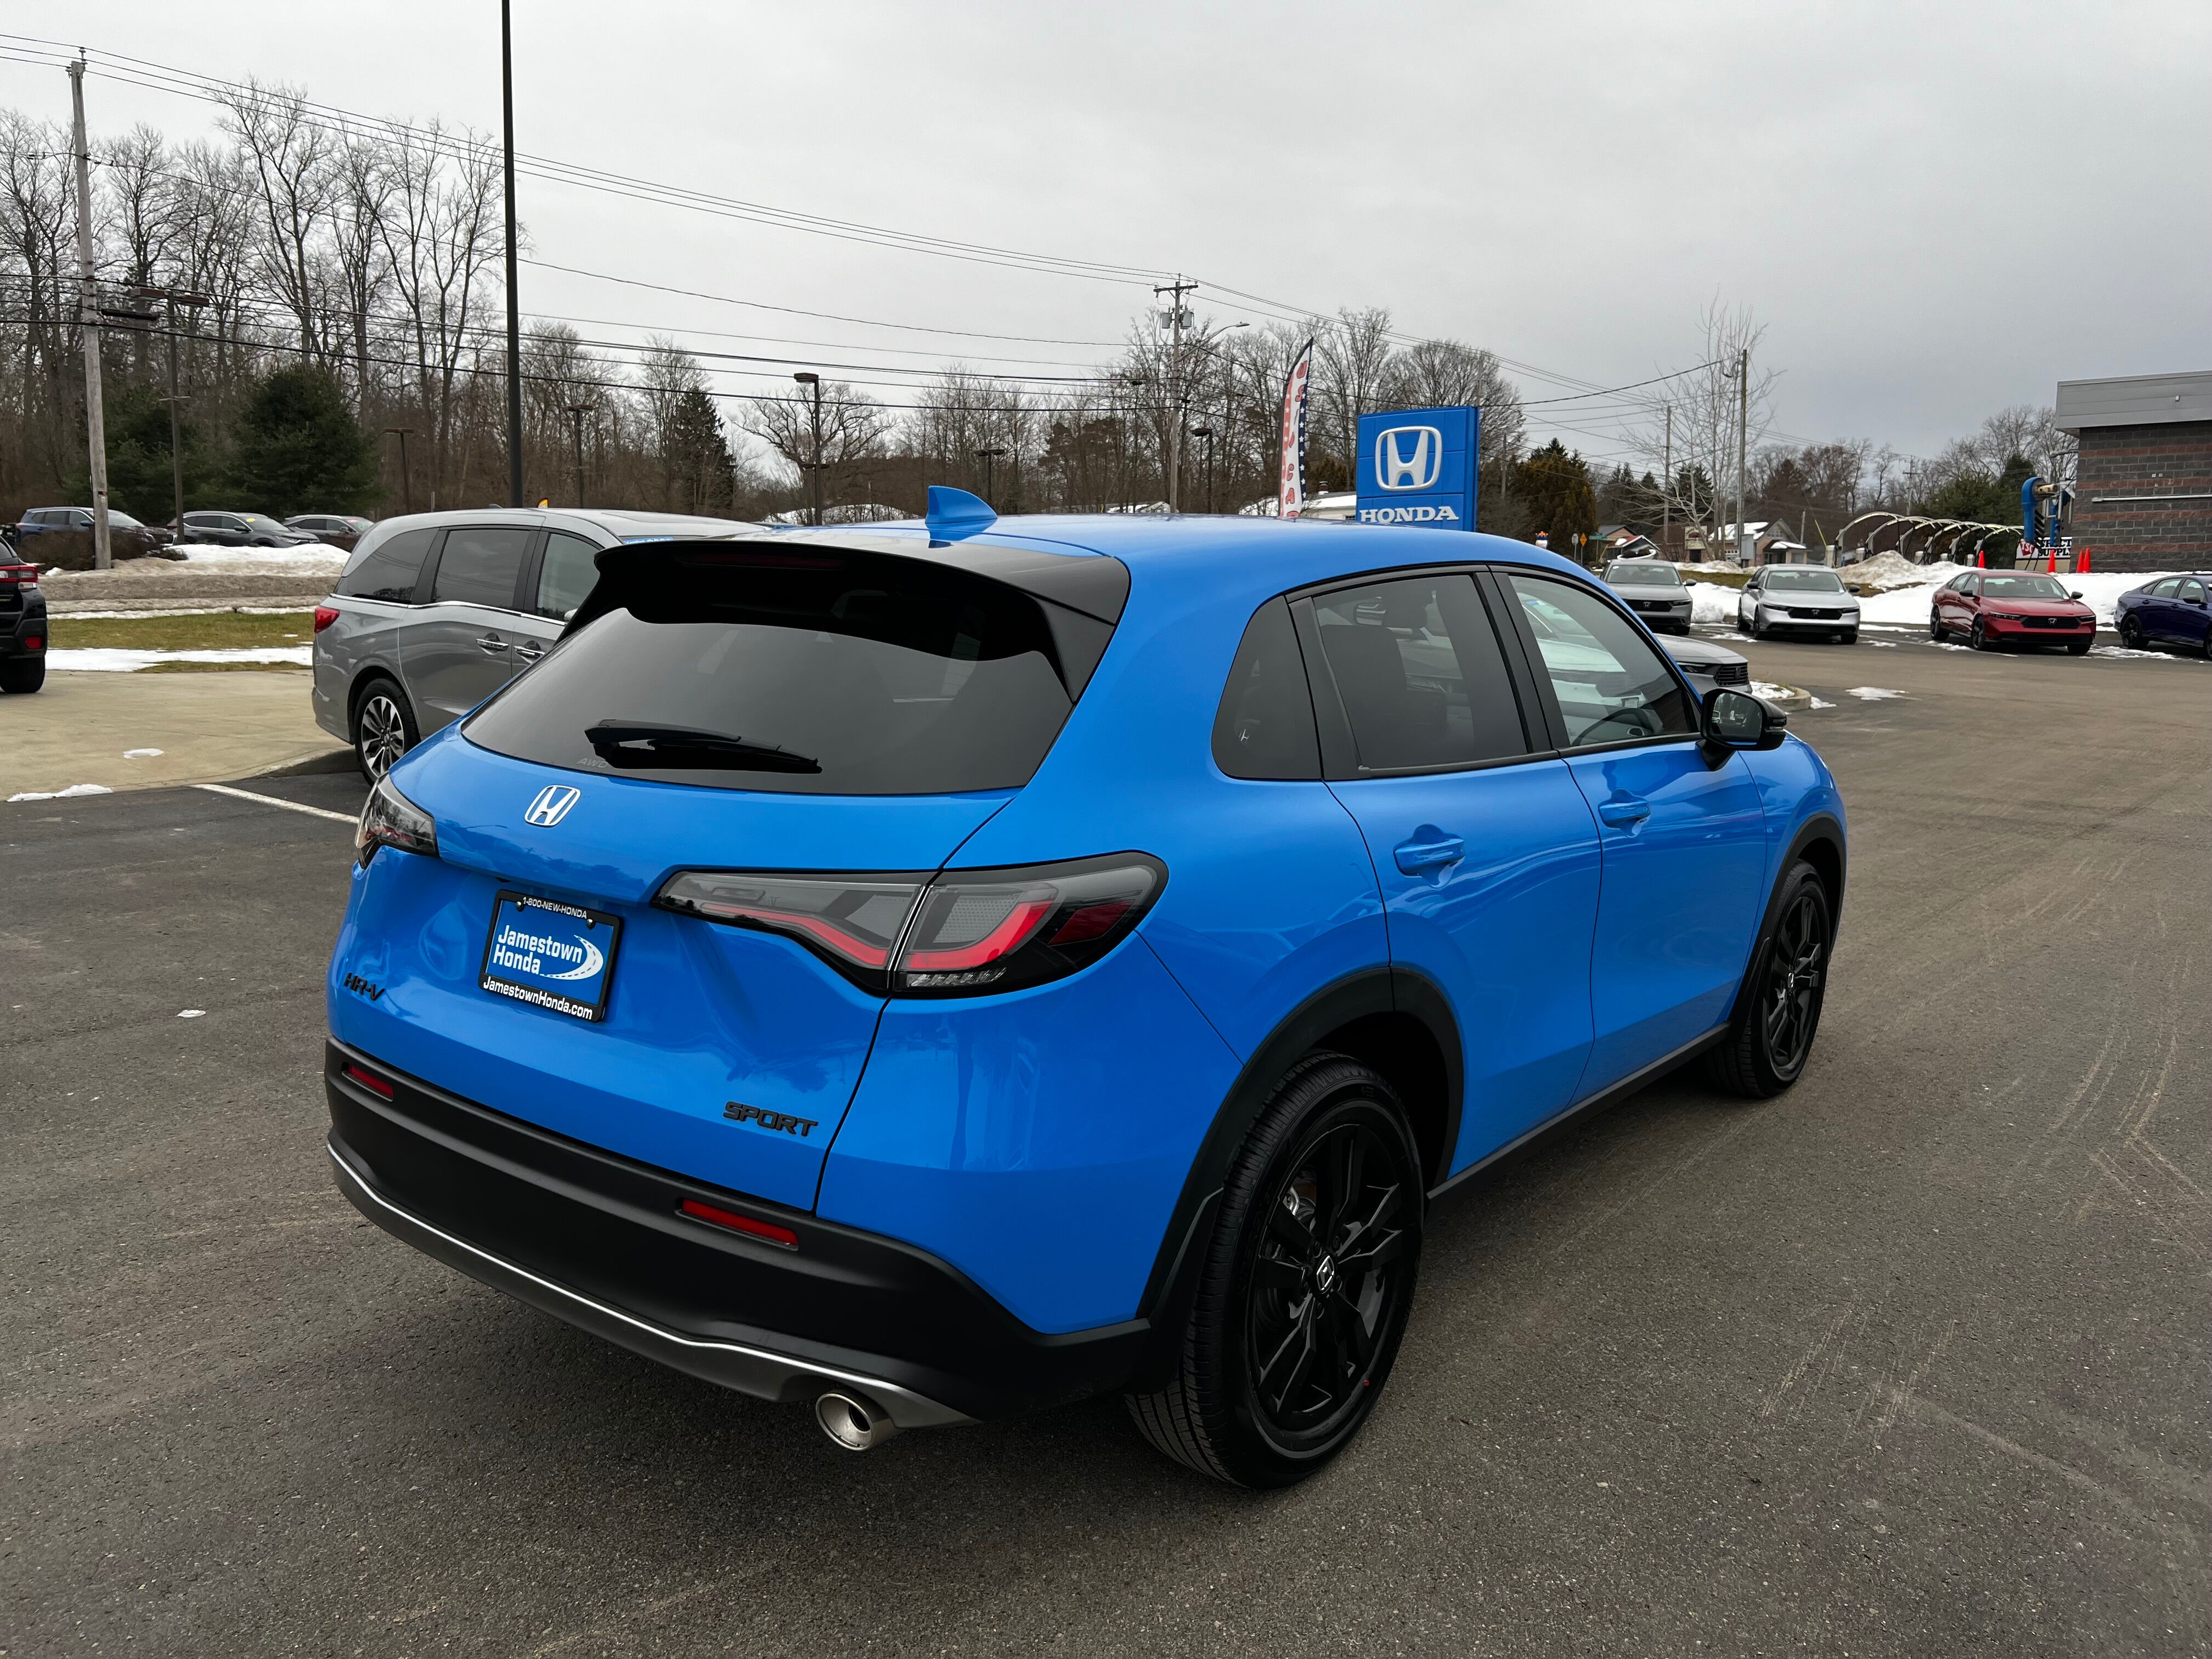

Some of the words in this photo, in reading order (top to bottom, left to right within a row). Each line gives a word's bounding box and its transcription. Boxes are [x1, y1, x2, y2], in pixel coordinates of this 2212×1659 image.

[1359, 506, 1459, 523] HONDA
[2020, 541, 2034, 554] TSC
[577, 758, 608, 768] AWD
[522, 896, 587, 919] 1-800-NEW-HONDA
[498, 925, 583, 963] Jamestown
[493, 944, 541, 975] Honda
[343, 972, 386, 1001] HR-V
[483, 977, 593, 1020] JamestownHonda.com
[723, 1101, 819, 1137] SPORT
